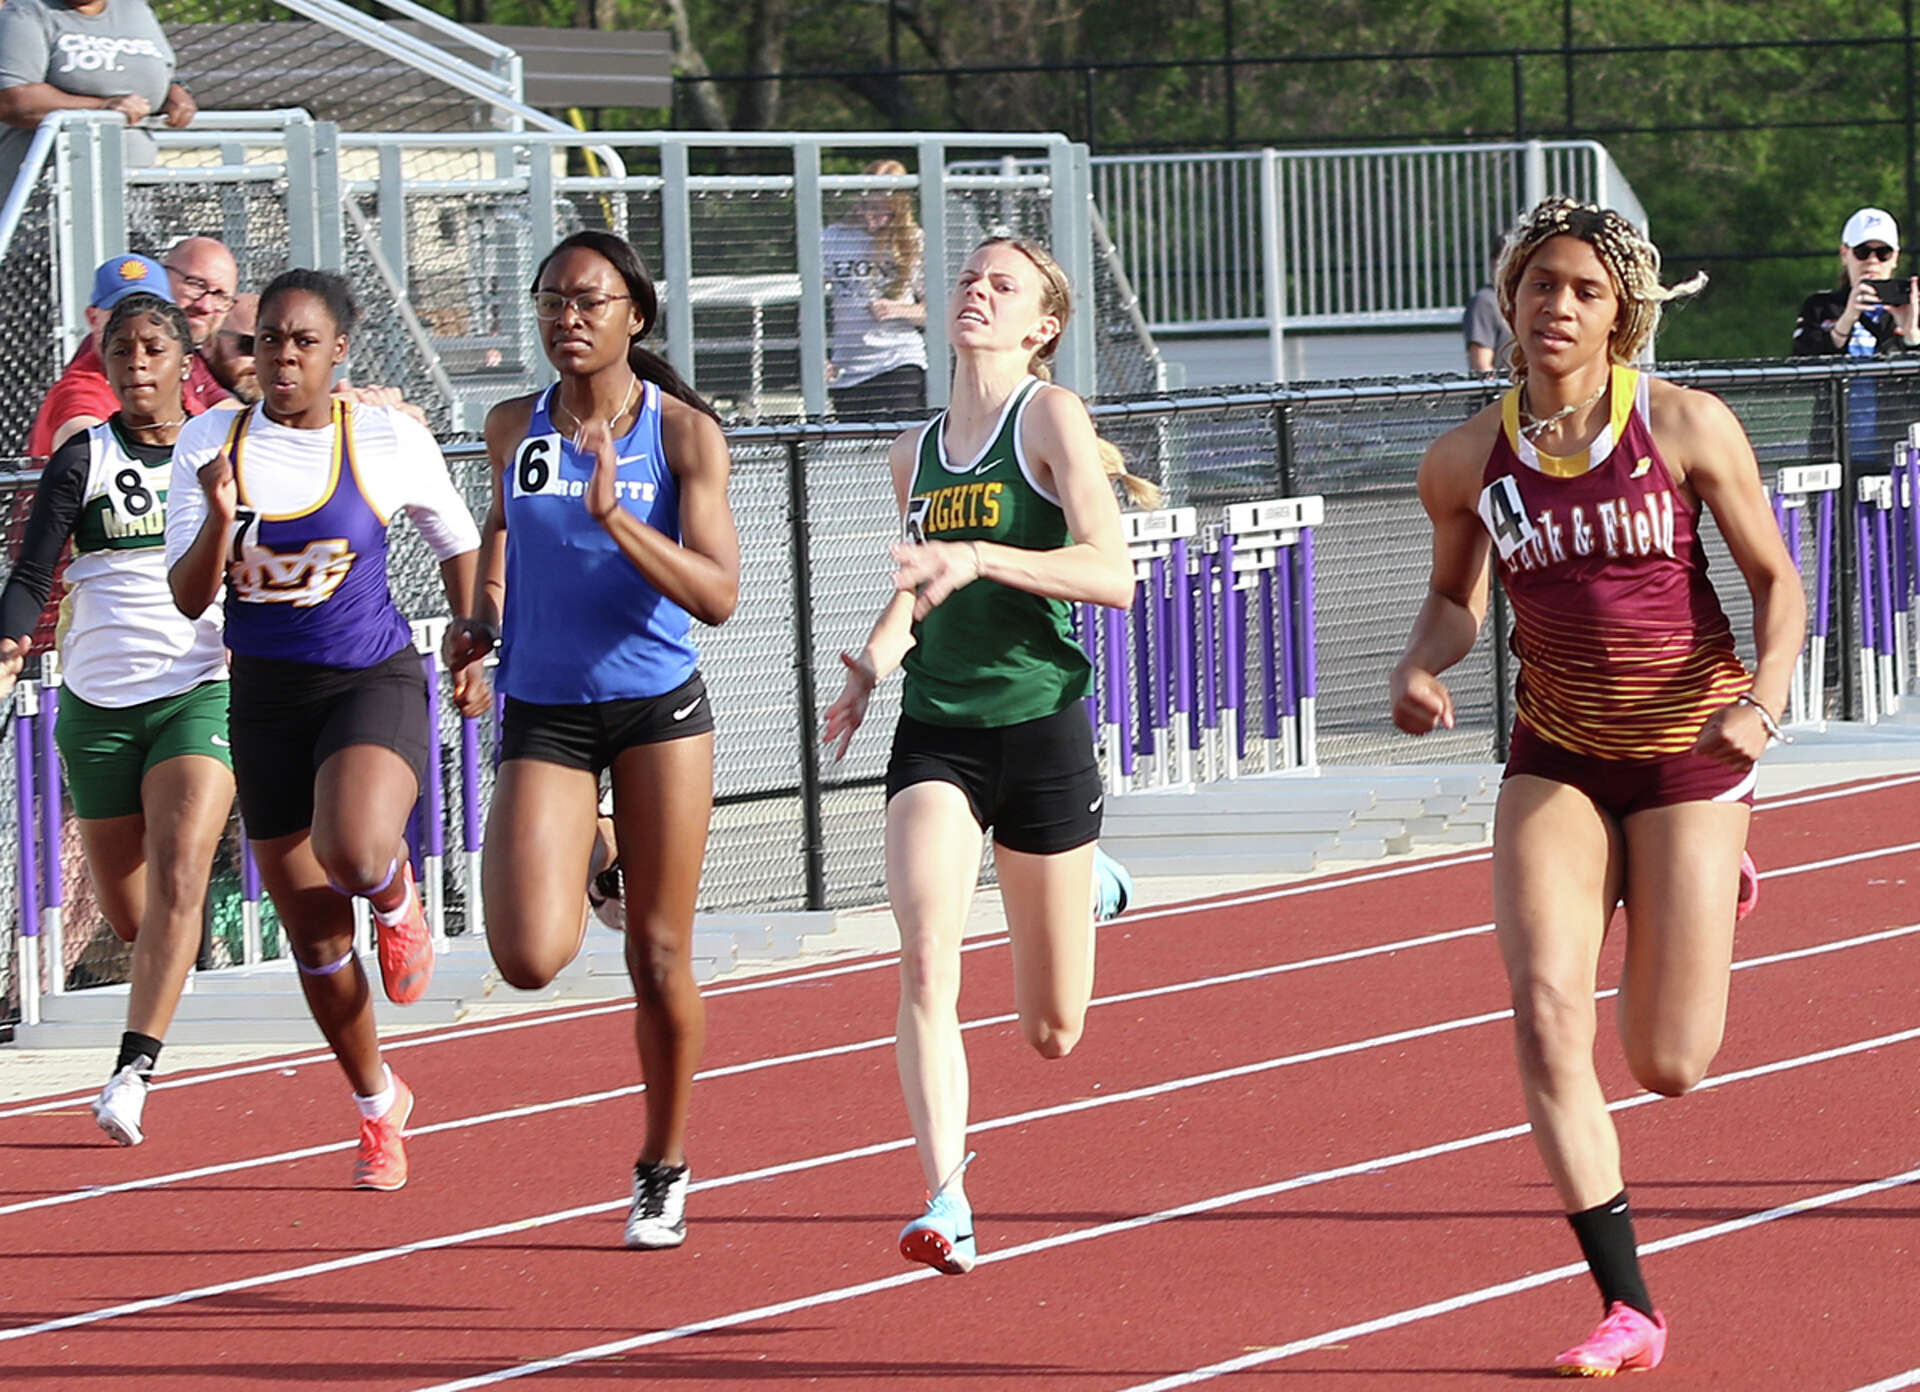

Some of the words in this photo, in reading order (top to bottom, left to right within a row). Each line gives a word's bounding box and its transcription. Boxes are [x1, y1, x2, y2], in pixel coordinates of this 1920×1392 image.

[59, 50, 125, 72] JOY.
[115, 468, 153, 517] 8
[519, 439, 550, 493] 6
[916, 482, 1003, 533] IGHTS
[1490, 480, 1524, 544] 4
[1571, 505, 1595, 556] &
[1597, 490, 1676, 559] Field
[233, 509, 256, 562] 7
